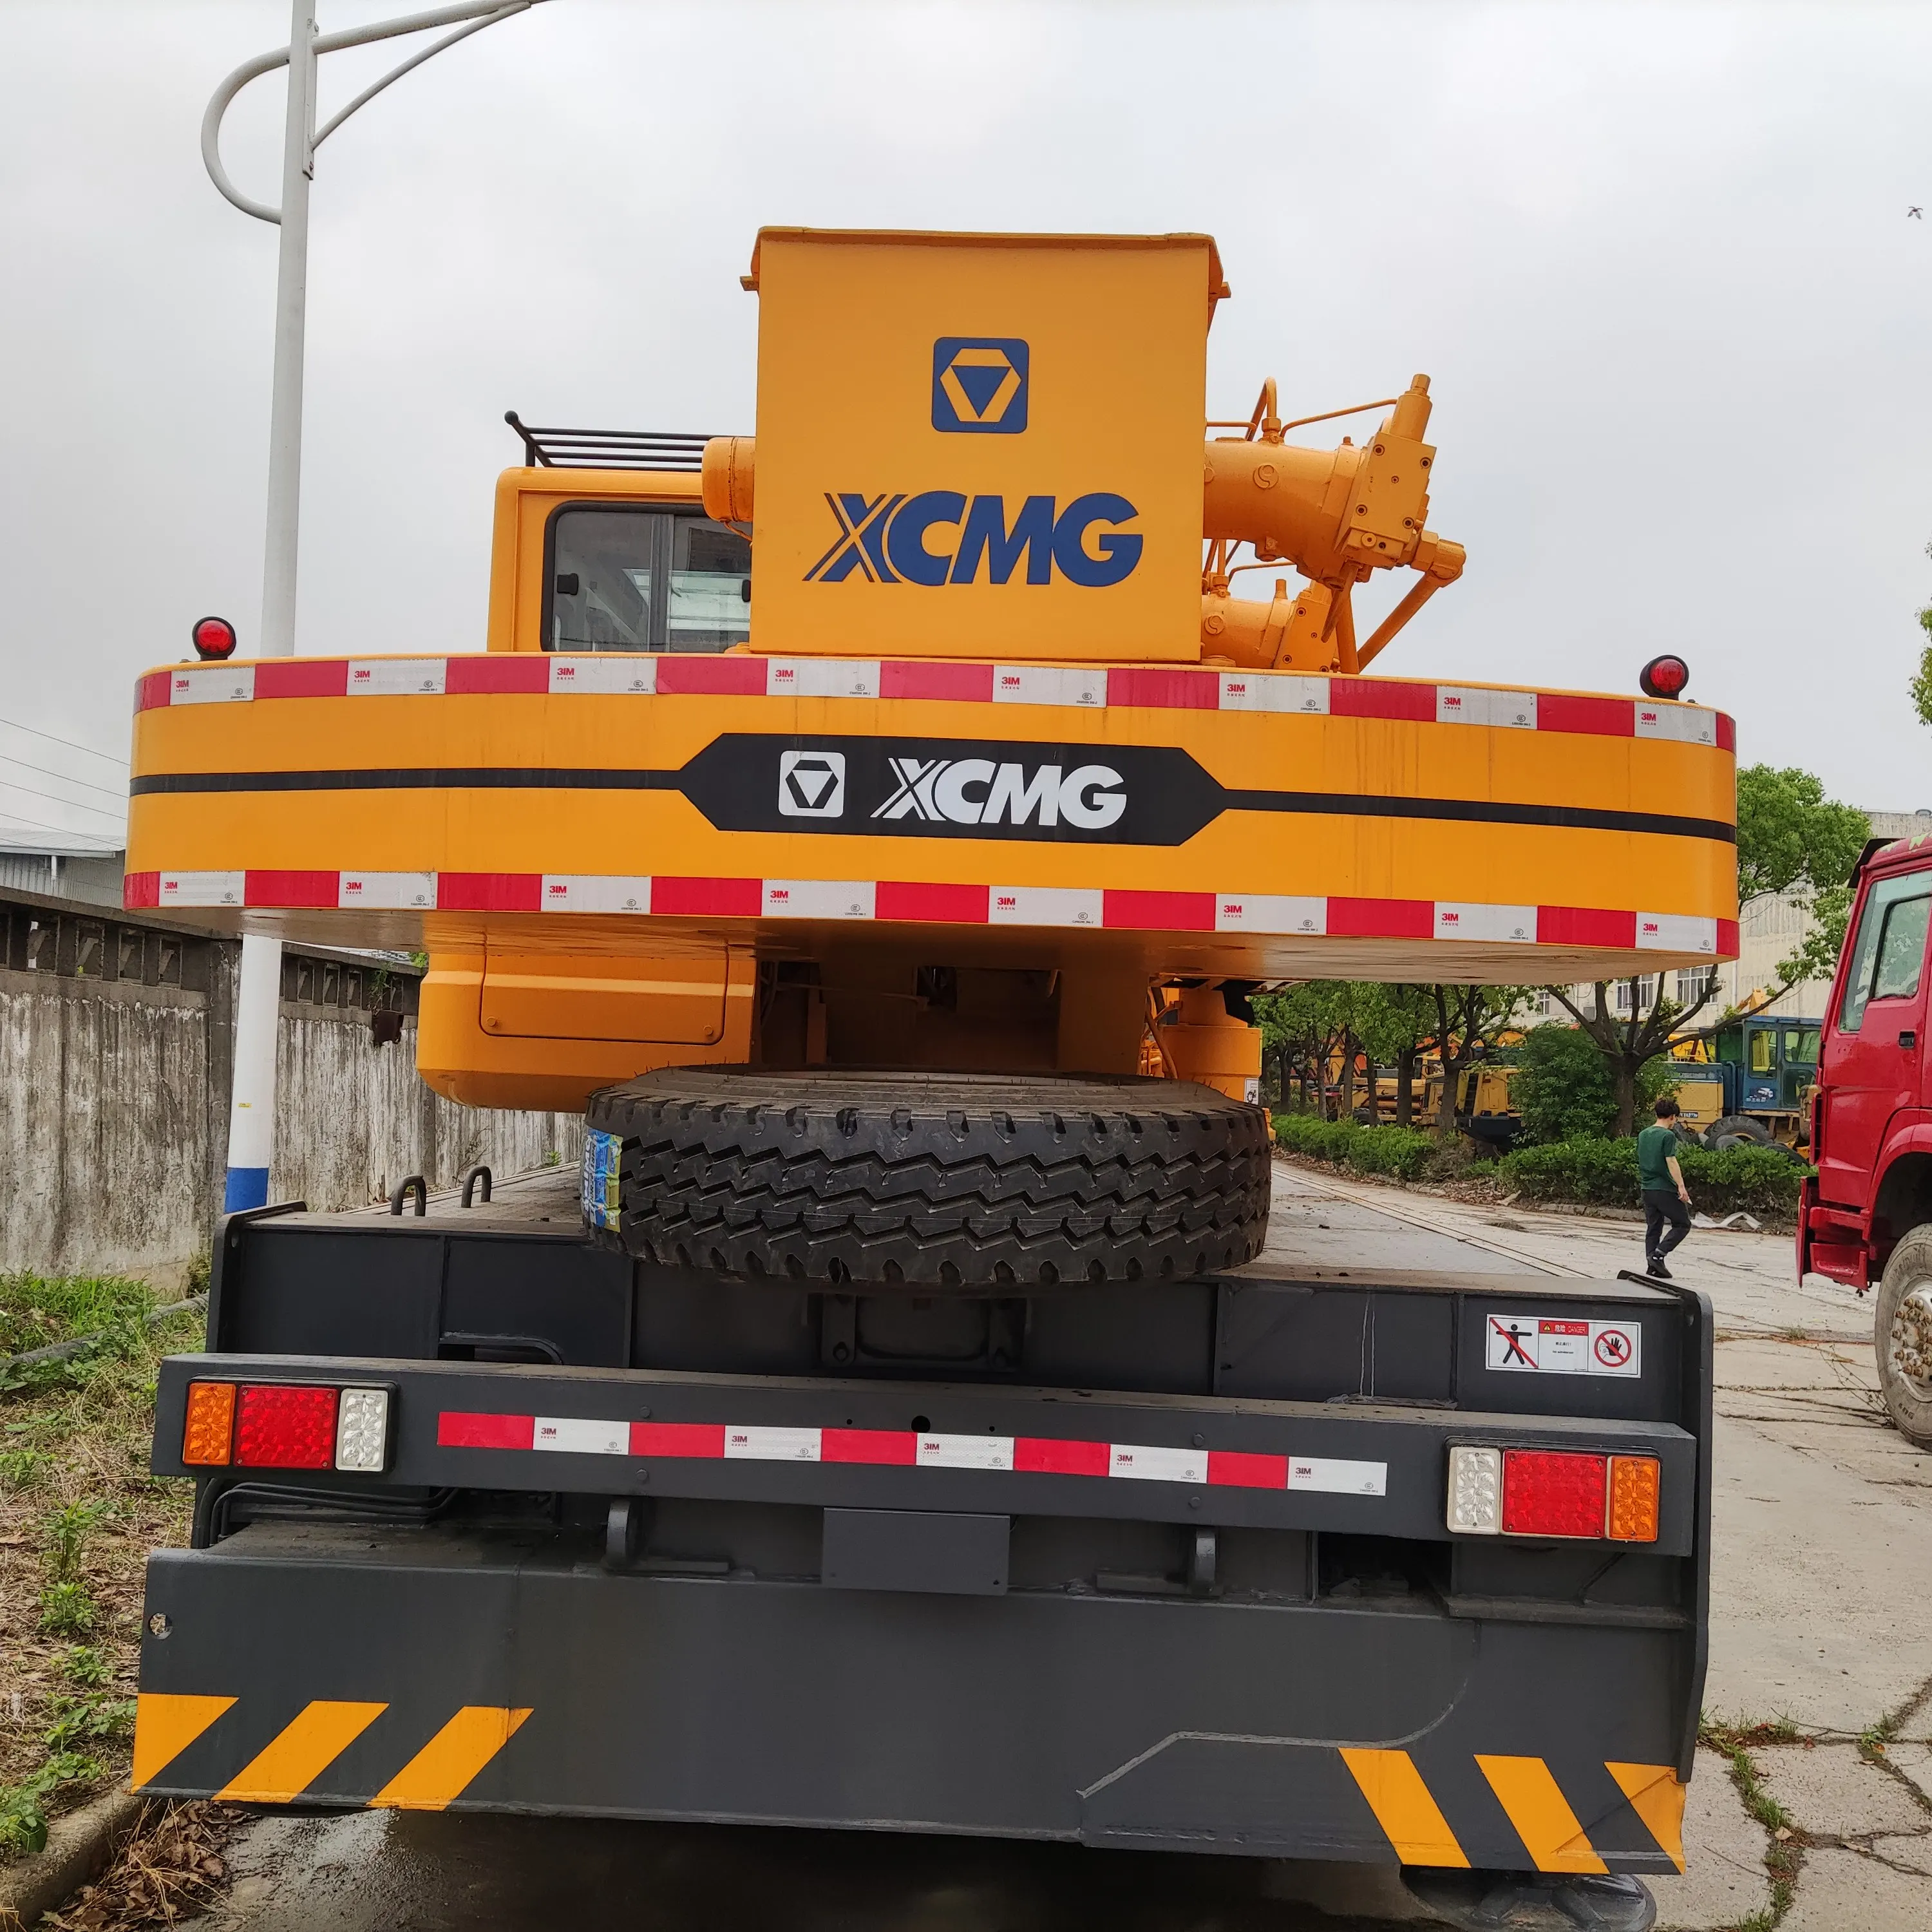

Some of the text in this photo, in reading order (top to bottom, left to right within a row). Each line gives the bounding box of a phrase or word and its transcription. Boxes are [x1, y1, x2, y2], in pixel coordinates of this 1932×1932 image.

[801, 490, 1144, 587] XCMG
[354, 670, 370, 679] 3M
[556, 667, 575, 676] 3M
[775, 669, 794, 678] 3M
[175, 679, 189, 688] 3M
[1001, 676, 1020, 685] 3M
[1226, 683, 1245, 692] 3M
[1443, 697, 1461, 706] 3M
[1640, 712, 1656, 722] 3M
[870, 757, 1127, 829] XCMG
[164, 881, 178, 889] 3M
[345, 882, 362, 890] 3M
[549, 885, 567, 894] 3M
[770, 890, 789, 899] 3M
[997, 896, 1016, 906] 3M
[1223, 905, 1242, 914] 3M
[1441, 913, 1459, 922] 3M
[1643, 923, 1658, 932] 3M
[540, 1427, 557, 1435] 3M
[732, 1435, 748, 1443] 3M
[923, 1443, 940, 1451] 3M
[1117, 1454, 1133, 1463] 3M
[1295, 1467, 1312, 1475] 3M
